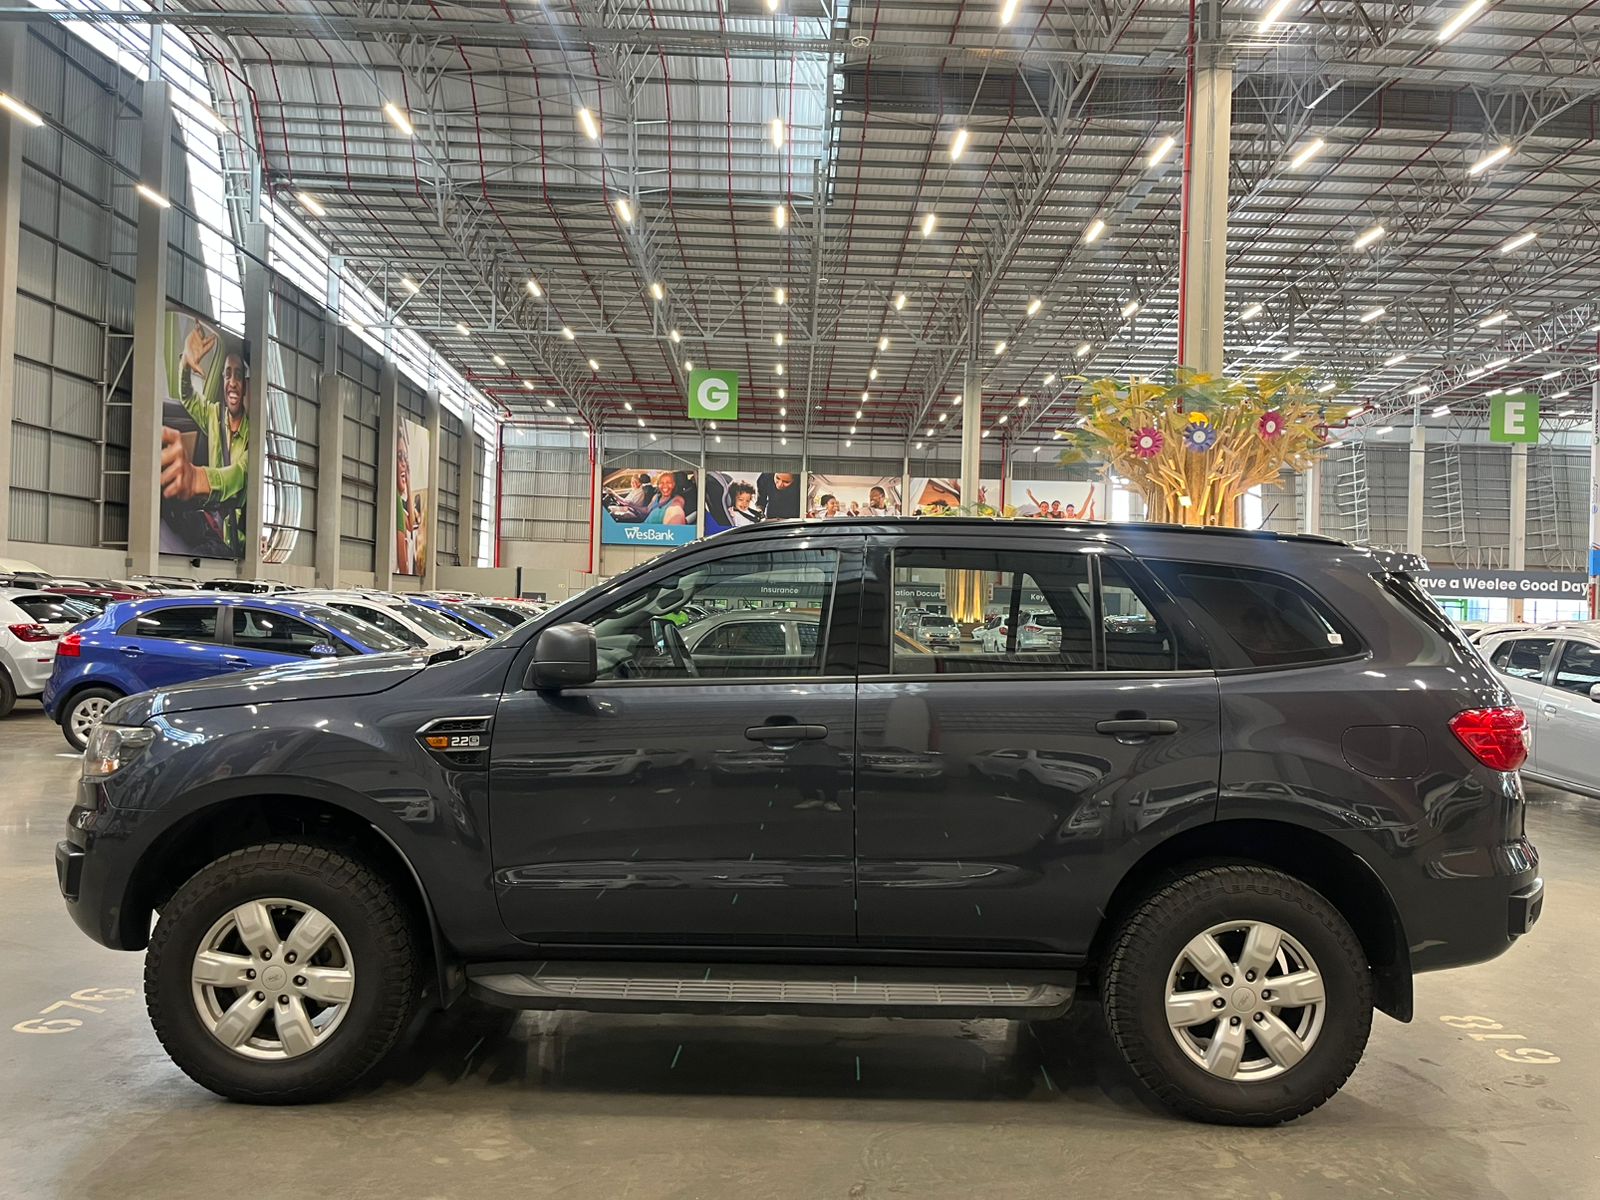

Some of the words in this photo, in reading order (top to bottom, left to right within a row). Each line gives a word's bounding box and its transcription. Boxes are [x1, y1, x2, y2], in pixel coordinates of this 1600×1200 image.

[697, 377, 729, 411] G
[1504, 402, 1526, 435] E
[624, 526, 674, 541] WesBank
[760, 586, 799, 594] Insurance
[1450, 579, 1460, 589] a
[1462, 578, 1517, 591] Weelee
[1520, 579, 1558, 592] Good
[1561, 581, 1589, 596] Day
